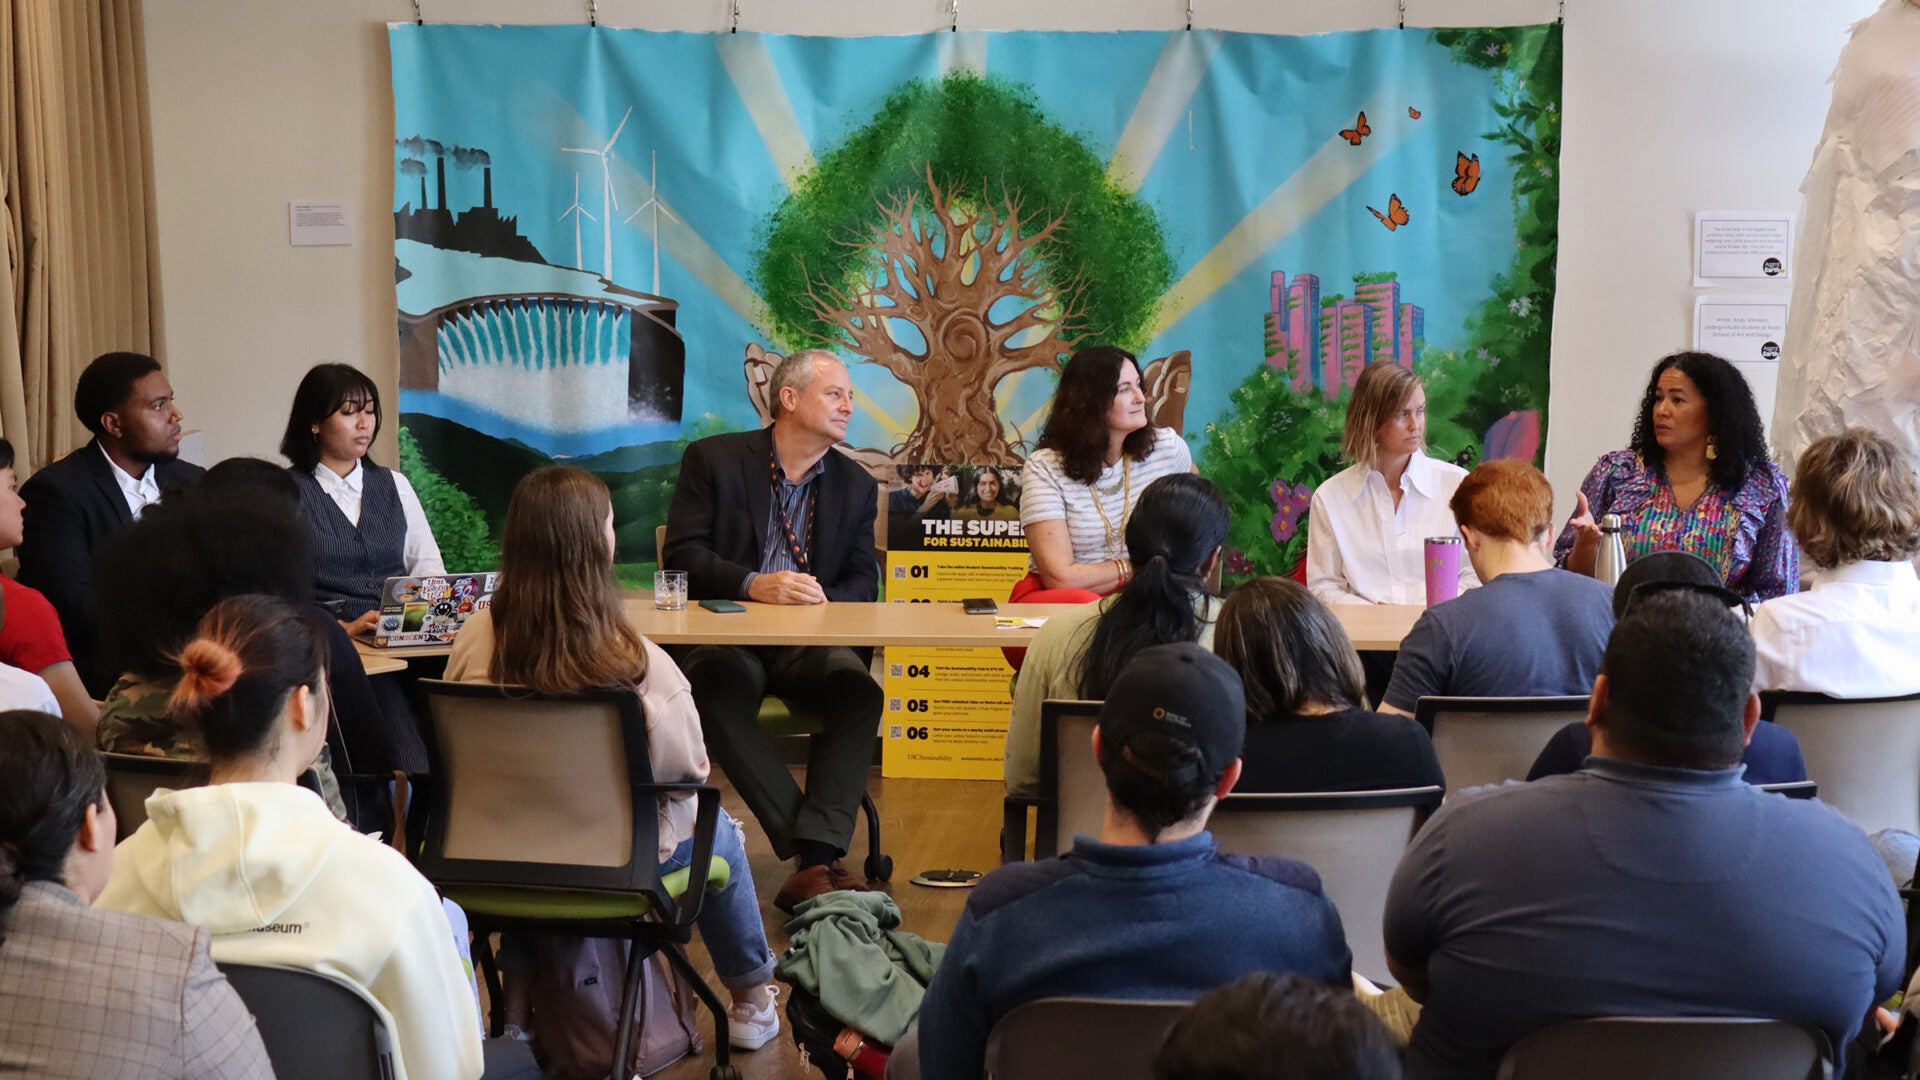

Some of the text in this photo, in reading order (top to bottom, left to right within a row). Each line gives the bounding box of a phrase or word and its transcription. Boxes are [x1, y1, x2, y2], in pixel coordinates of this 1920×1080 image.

[922, 520, 963, 535] THE
[924, 537, 948, 547] FOR
[911, 565, 928, 578] 01
[908, 665, 930, 678] 04
[907, 699, 928, 712] 05
[907, 727, 928, 740] 06
